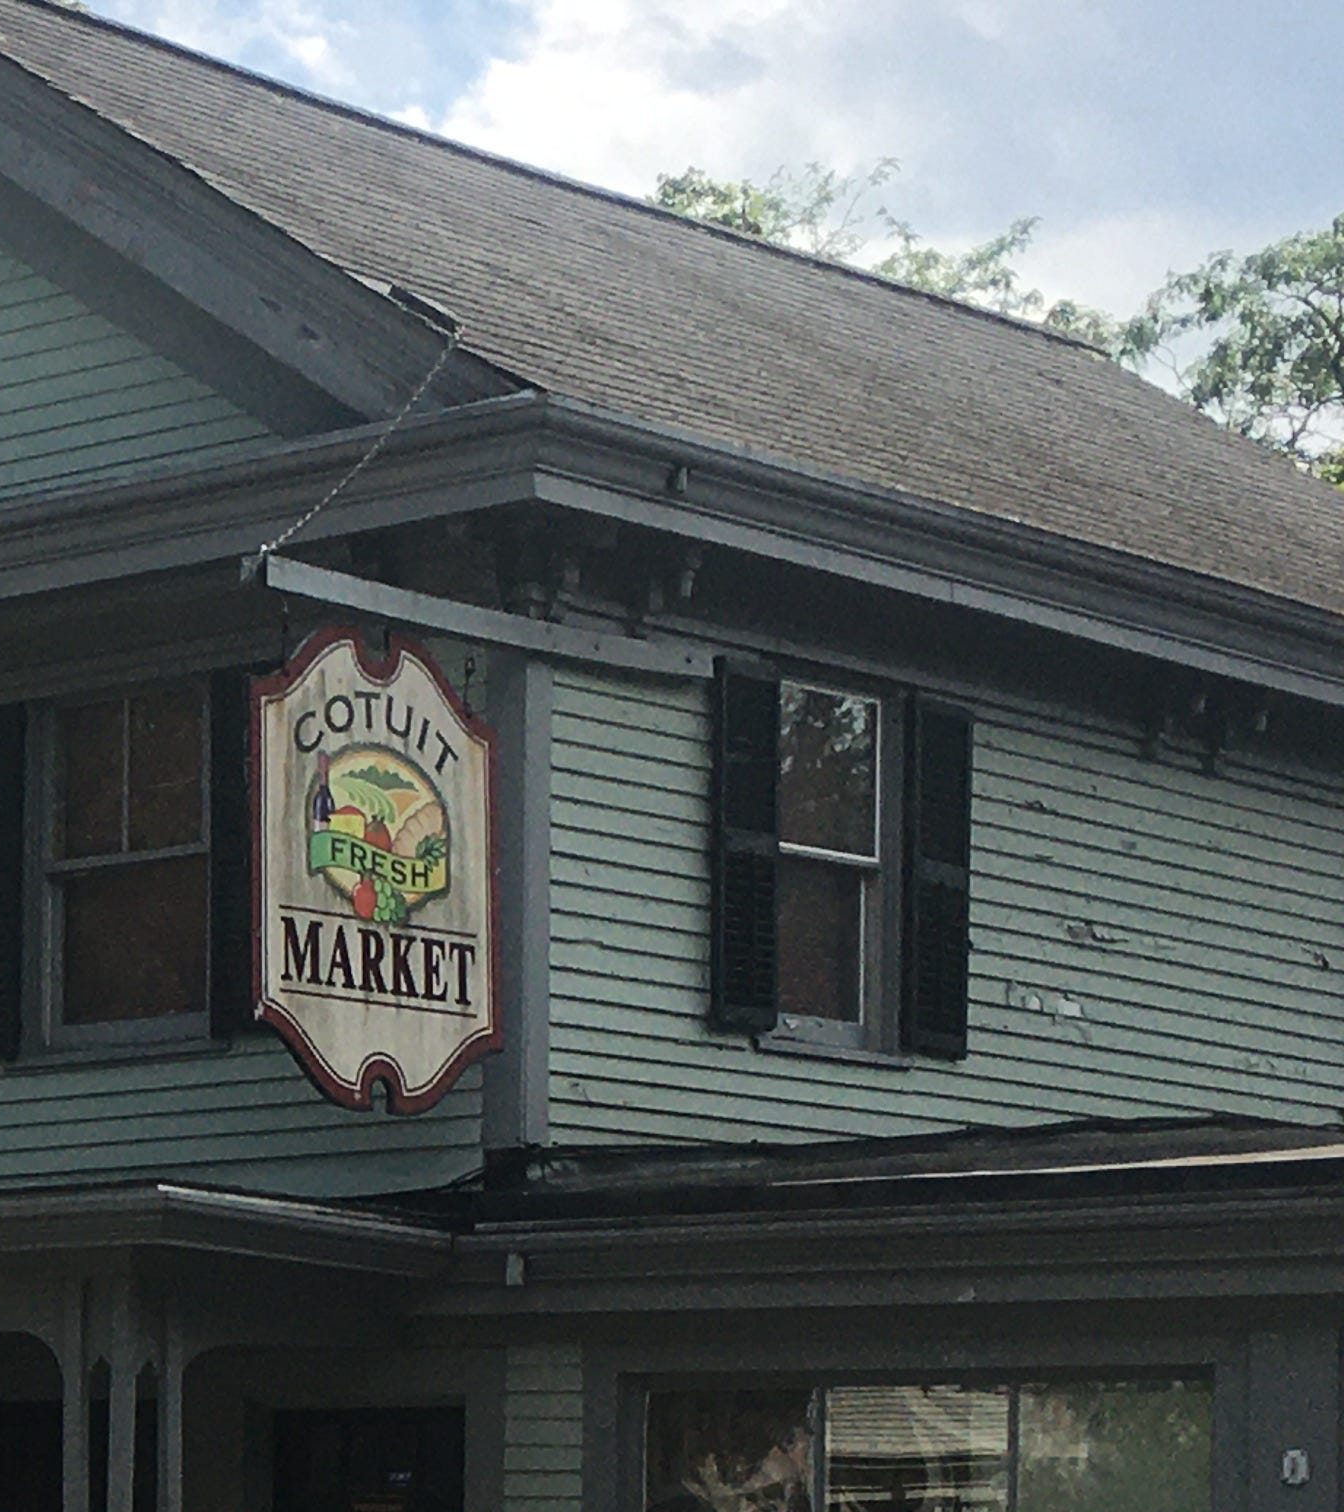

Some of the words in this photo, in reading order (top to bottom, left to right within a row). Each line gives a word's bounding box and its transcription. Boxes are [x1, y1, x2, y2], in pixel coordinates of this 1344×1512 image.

[292, 690, 459, 776] COTUIT
[329, 837, 430, 889] FRESH
[280, 915, 477, 1007] MARKET
